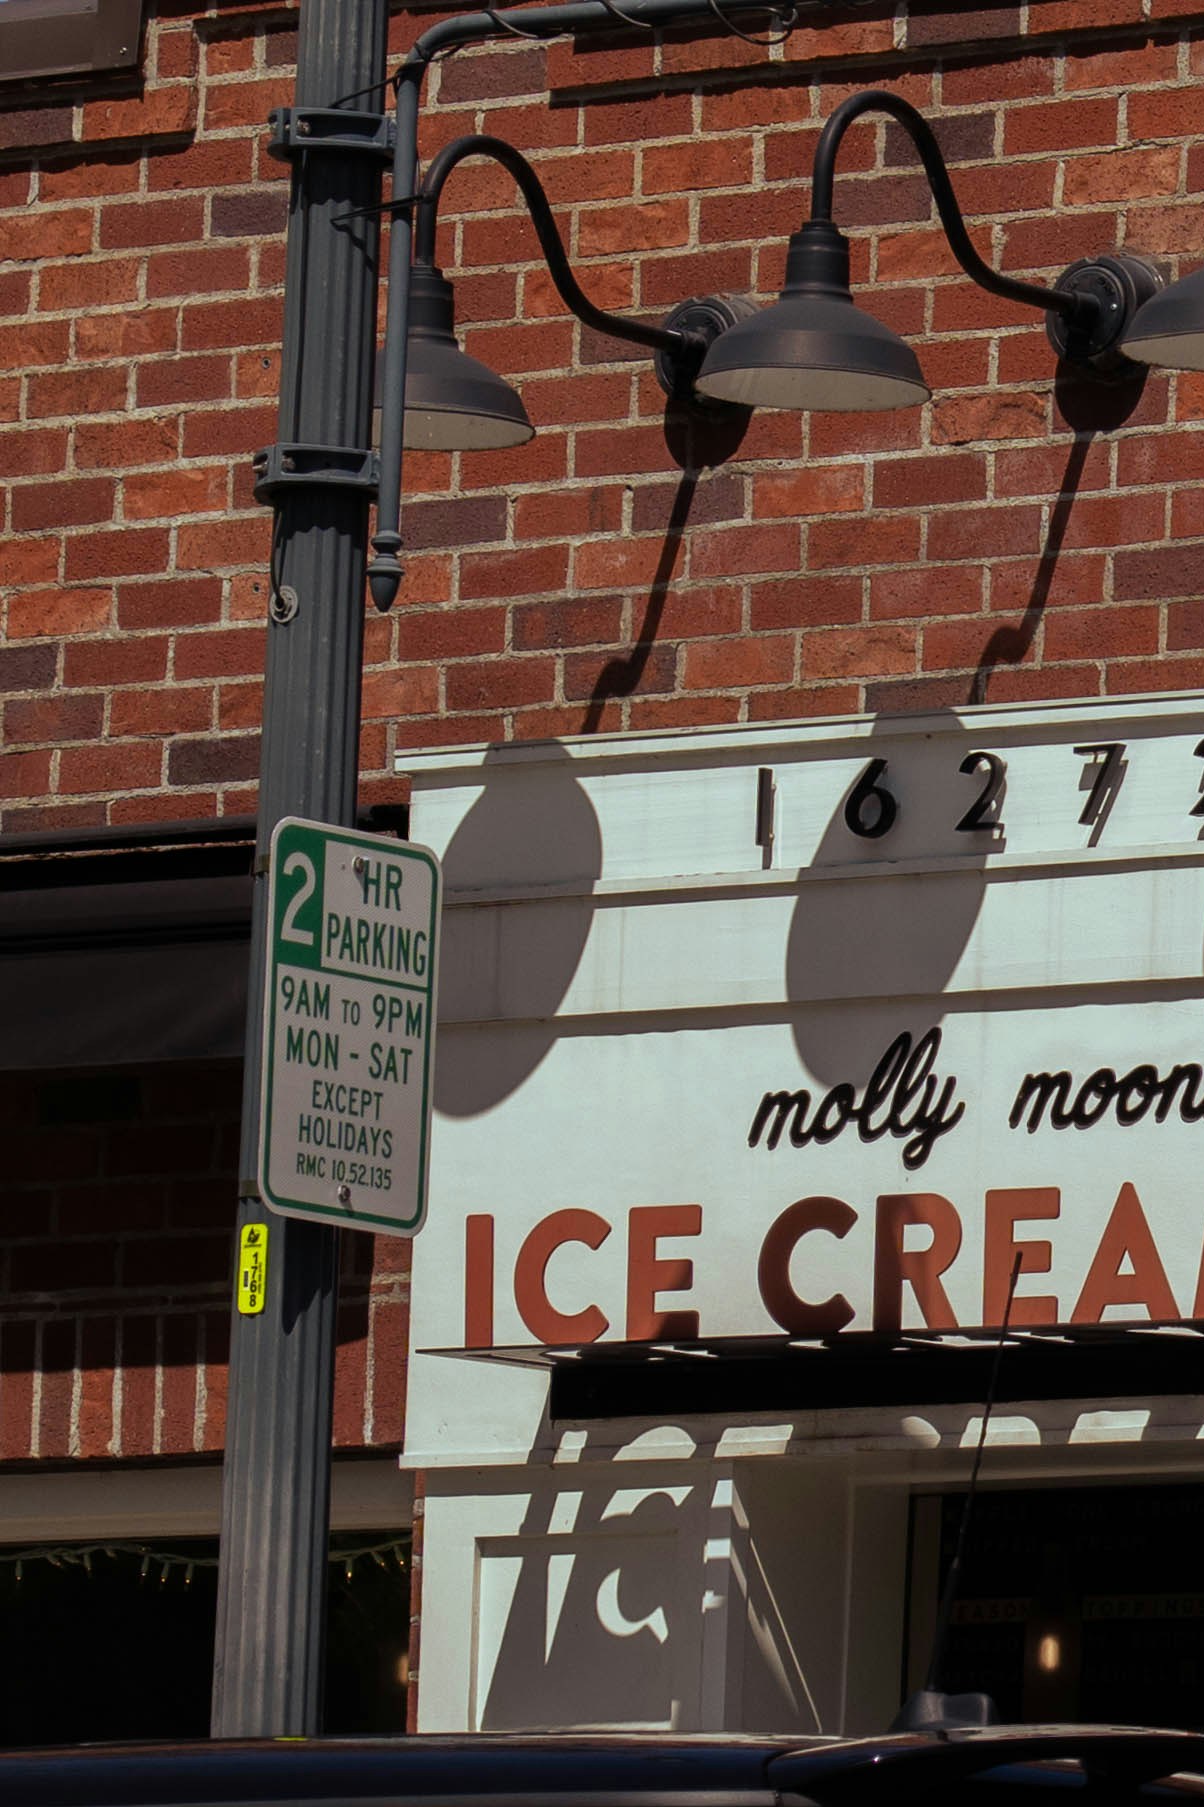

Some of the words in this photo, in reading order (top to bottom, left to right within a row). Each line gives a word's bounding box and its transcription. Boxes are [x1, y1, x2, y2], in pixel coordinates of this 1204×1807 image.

[280, 851, 317, 947] 2
[362, 859, 403, 911] HR
[325, 912, 427, 977] PARKING
[281, 976, 331, 1020] 9AM
[341, 999, 361, 1026] TO
[372, 994, 423, 1039] 9PM
[286, 1025, 340, 1072] MON
[368, 1042, 413, 1085] SAT
[312, 1080, 384, 1121] EXCEPT
[748, 1027, 965, 1171] molly
[298, 1113, 393, 1159] HOLIDAYS
[296, 1152, 326, 1179] RMC
[331, 1160, 393, 1191] 10.52.135
[248, 1251, 260, 1308] 1768
[464, 1204, 703, 1349] ICE
